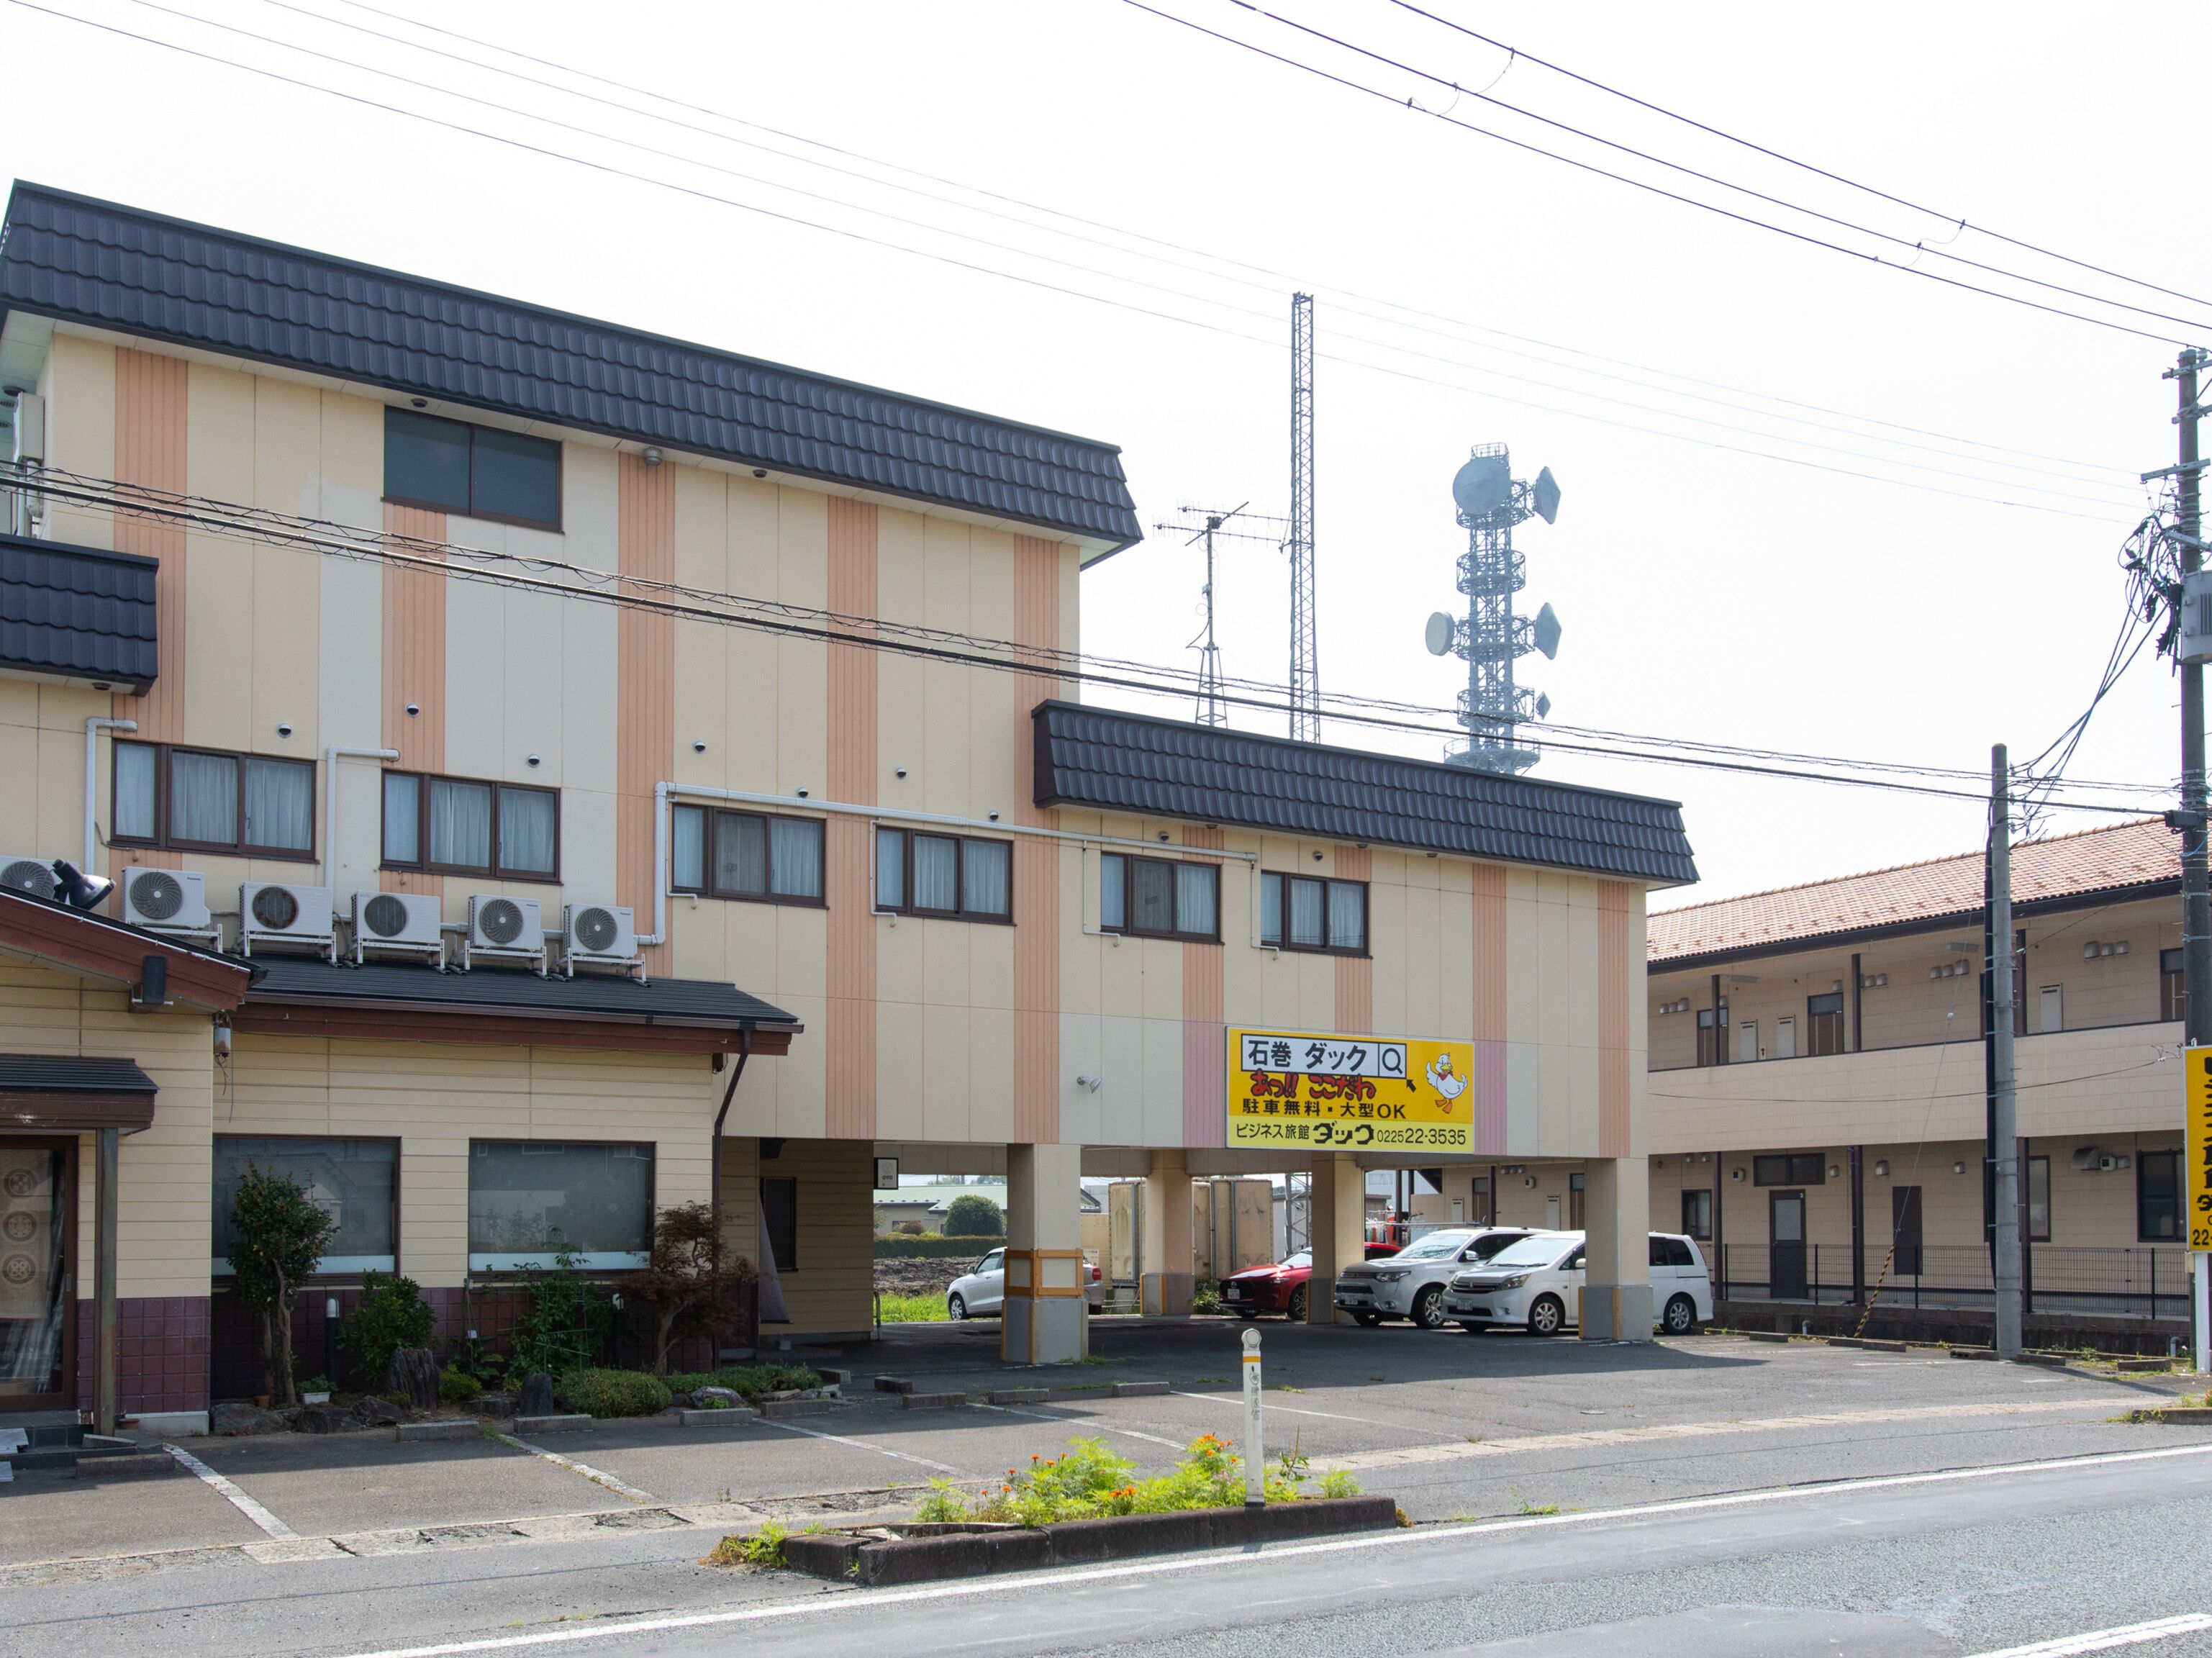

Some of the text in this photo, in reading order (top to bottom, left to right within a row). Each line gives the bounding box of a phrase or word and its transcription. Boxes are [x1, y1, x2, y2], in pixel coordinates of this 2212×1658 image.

[1248, 1040, 1367, 1072] 石巻 ダック
[1307, 1073, 1377, 1102] ここだね
[1236, 1122, 1310, 1140] ビジネス旅館
[1313, 1120, 1374, 1146] ダック
